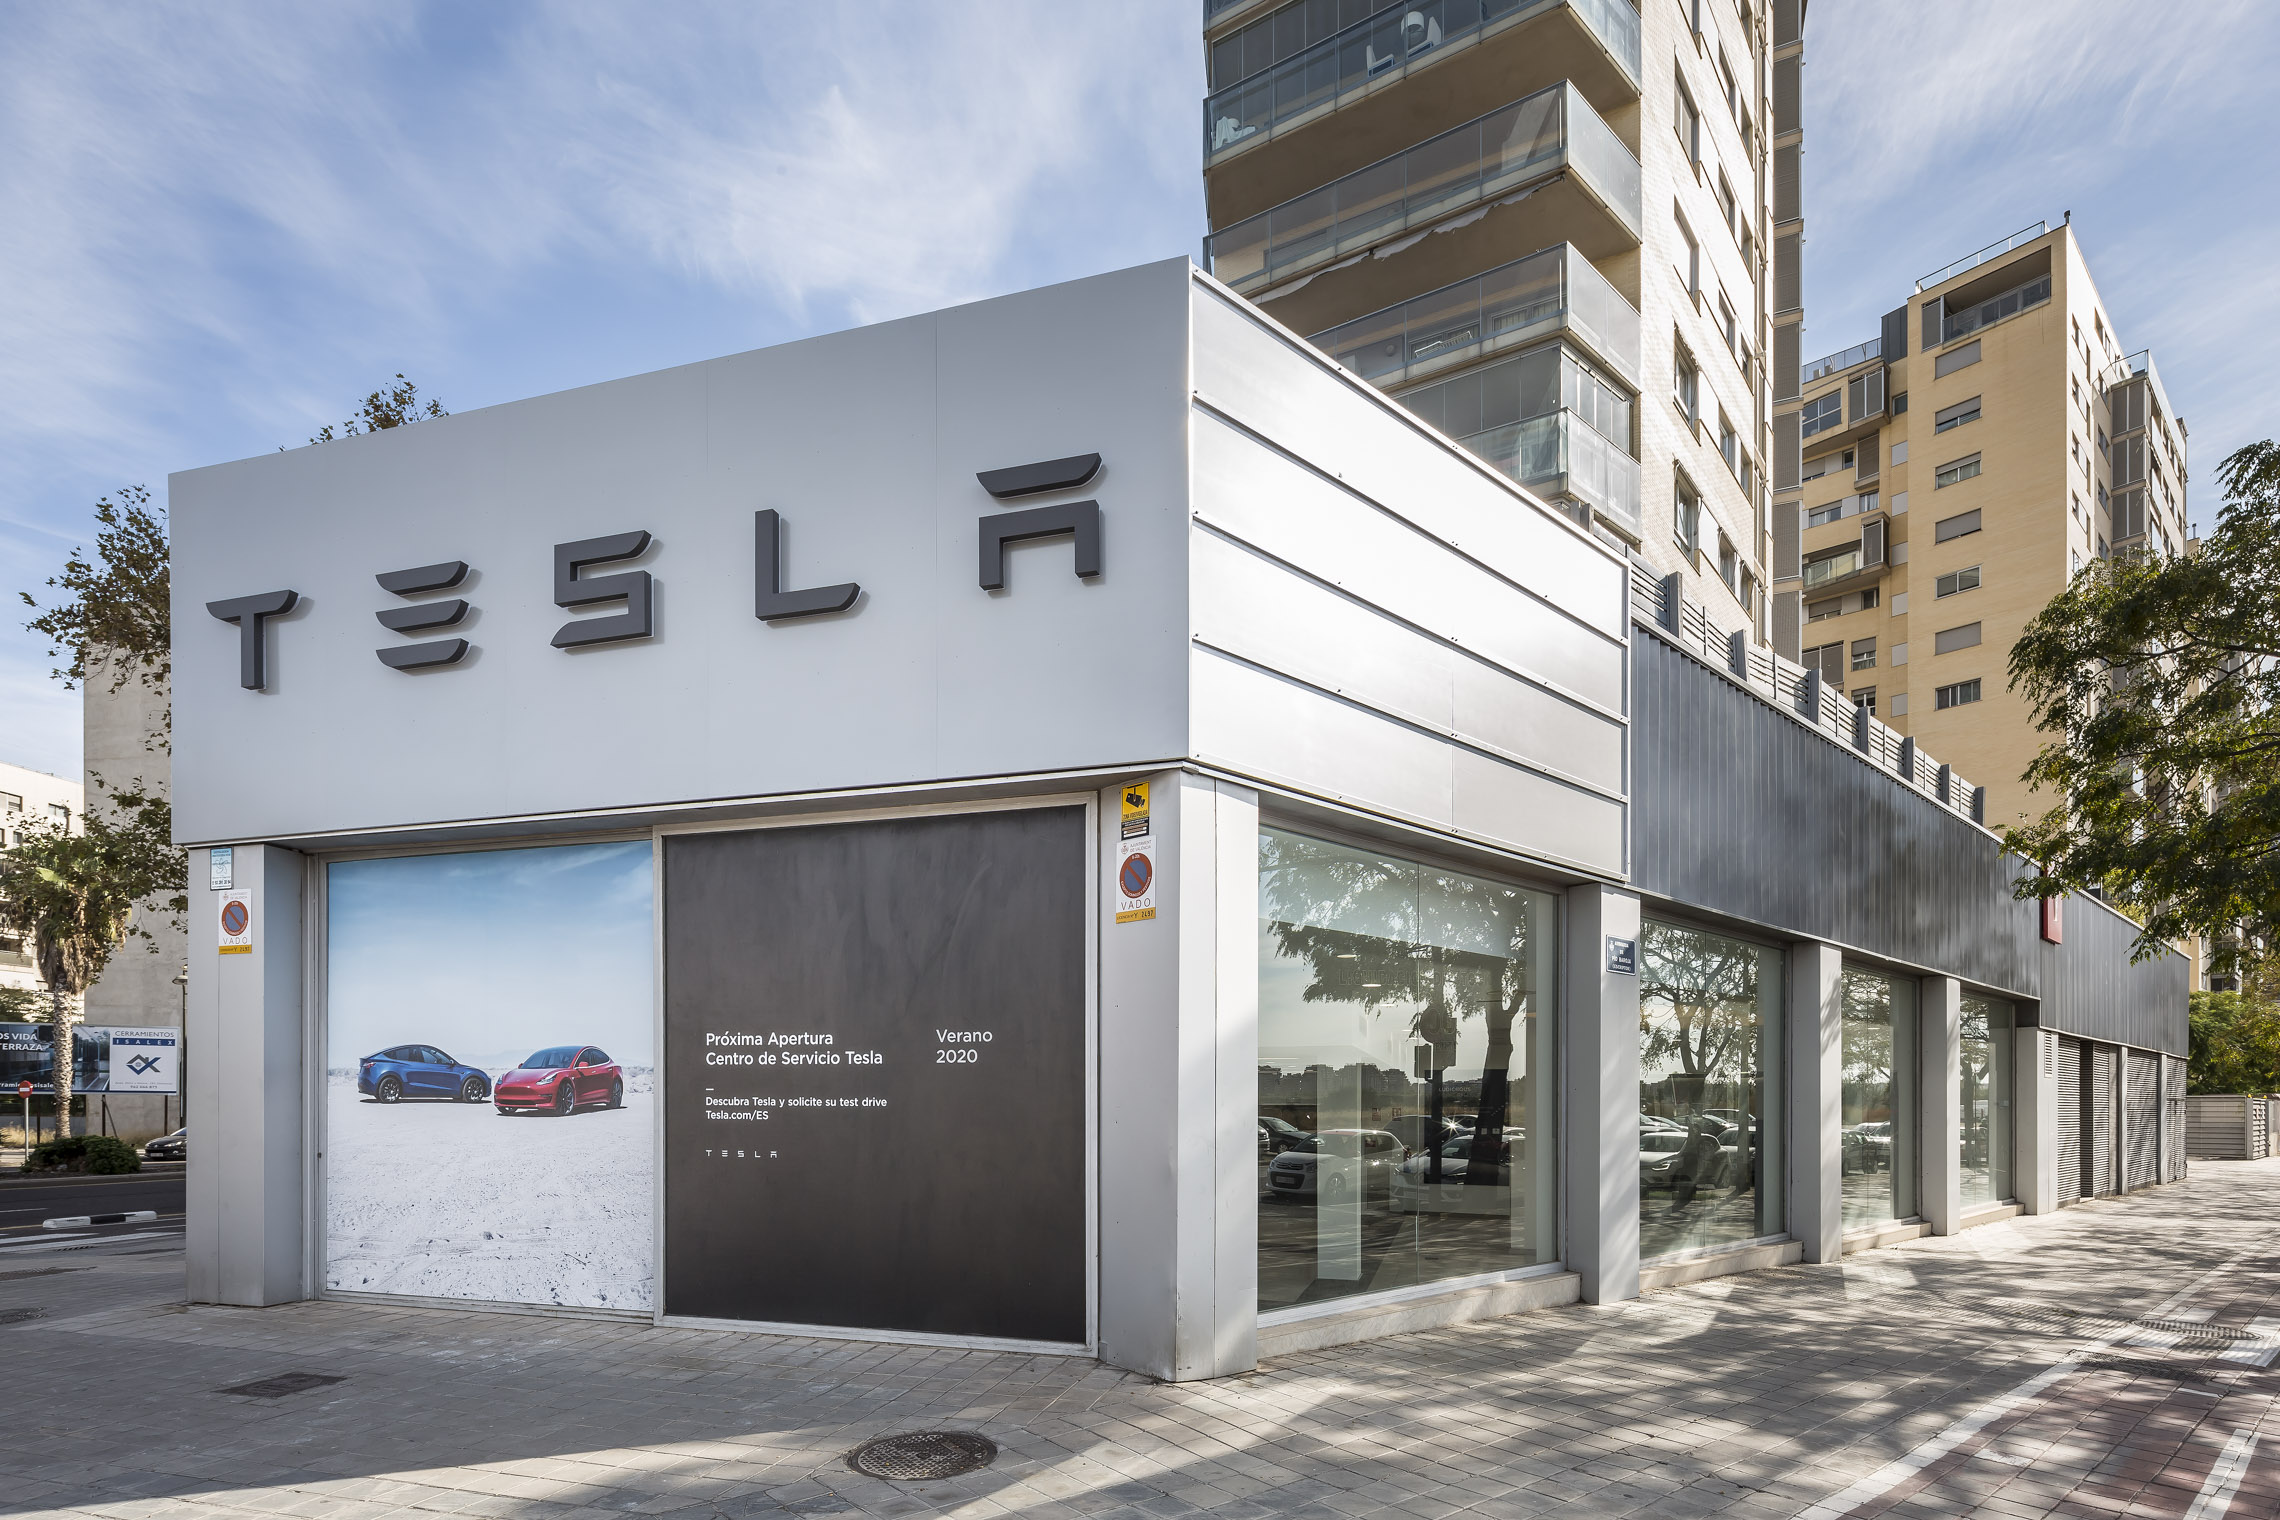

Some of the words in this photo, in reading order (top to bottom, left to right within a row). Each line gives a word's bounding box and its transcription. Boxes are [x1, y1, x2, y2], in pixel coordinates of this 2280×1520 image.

[206, 452, 1102, 692] TESLA
[1121, 898, 1151, 911] VADO
[223, 937, 248, 945] VADO
[114, 1030, 175, 1038] CERRAMIENTOS
[706, 1031, 763, 1047] Próxima
[768, 1032, 834, 1048] Apertura
[936, 1029, 993, 1043] Verano
[706, 1052, 754, 1066] Centro
[758, 1051, 777, 1065] de
[781, 1051, 841, 1065] Servicio
[845, 1050, 883, 1065] Tesla
[936, 1049, 978, 1064] 2020
[706, 1096, 750, 1107] Descubra
[752, 1096, 777, 1107] Tesla
[779, 1098, 785, 1108] y
[788, 1096, 822, 1107] solicite
[825, 1099, 837, 1107] su
[839, 1097, 859, 1107] test
[862, 1096, 888, 1107] drive
[706, 1110, 769, 1121] Tesla.com/ES
[706, 1150, 778, 1159] TESLA
